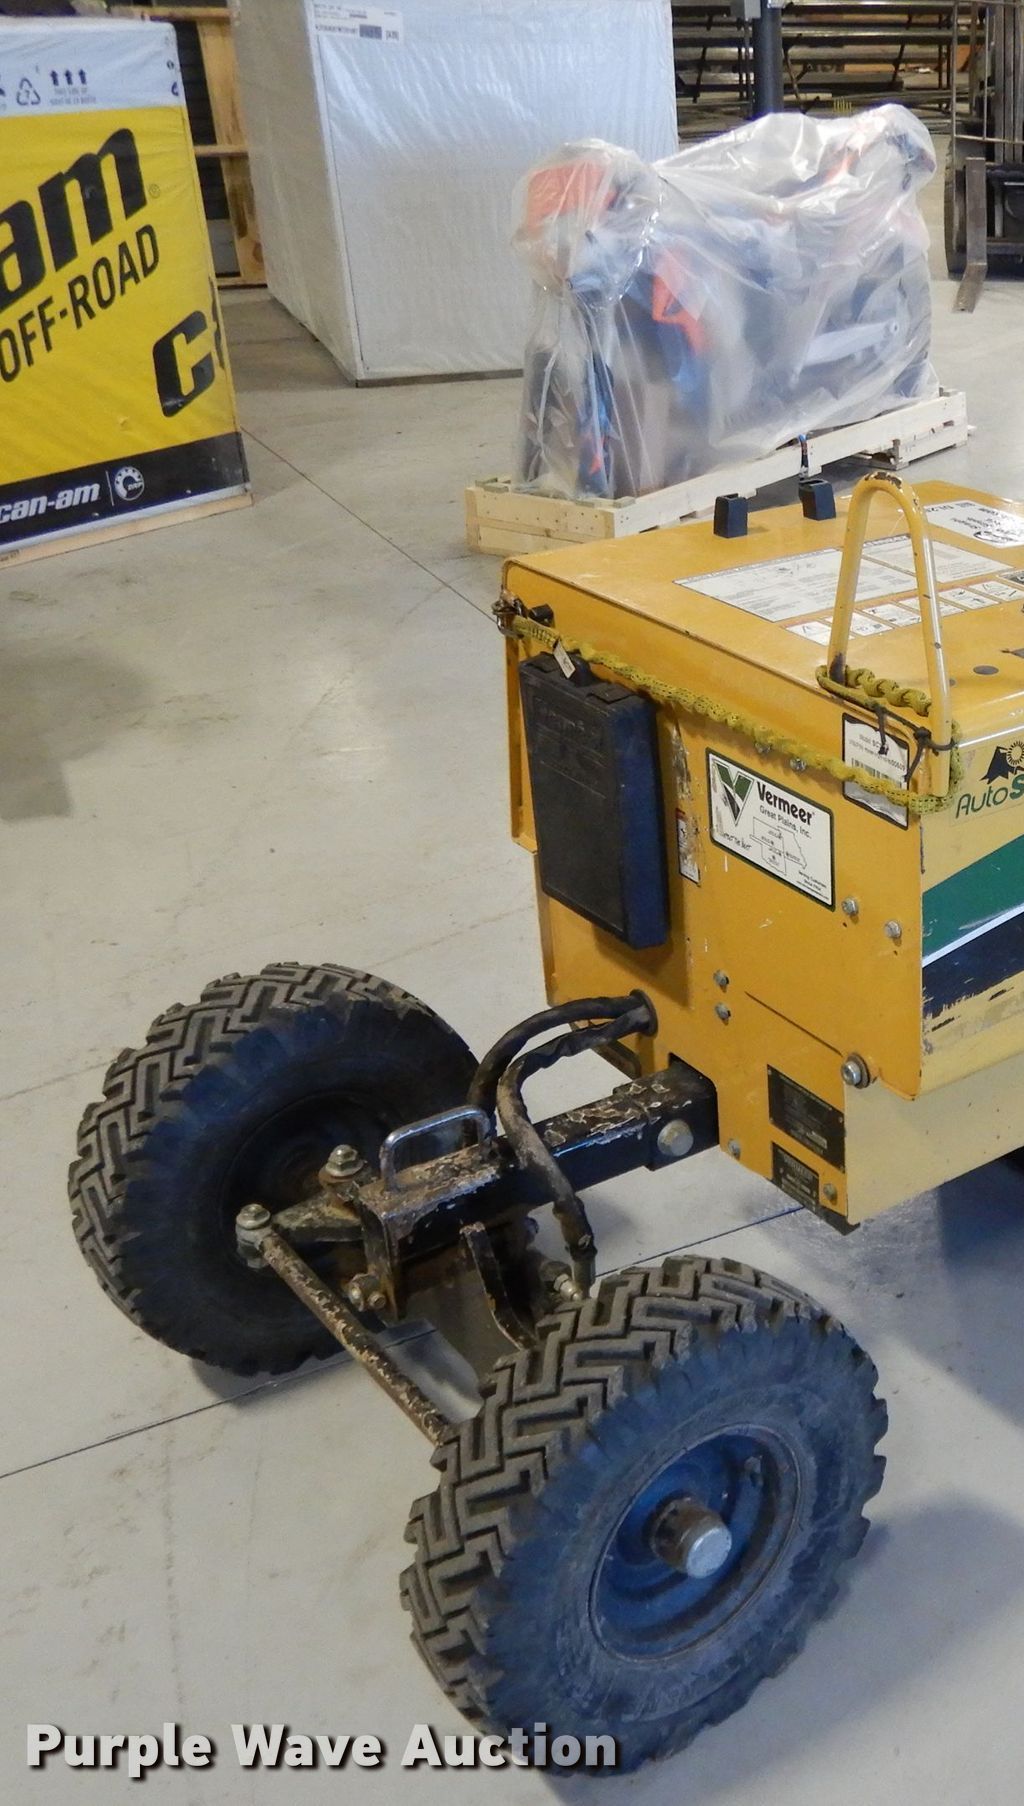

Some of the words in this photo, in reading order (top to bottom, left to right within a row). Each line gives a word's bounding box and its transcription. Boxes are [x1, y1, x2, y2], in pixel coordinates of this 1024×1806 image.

[0, 224, 160, 383] OFF-ROAD
[0, 482, 101, 524] can-am
[756, 781, 813, 826] Vermeer
[759, 804, 777, 821] Great
